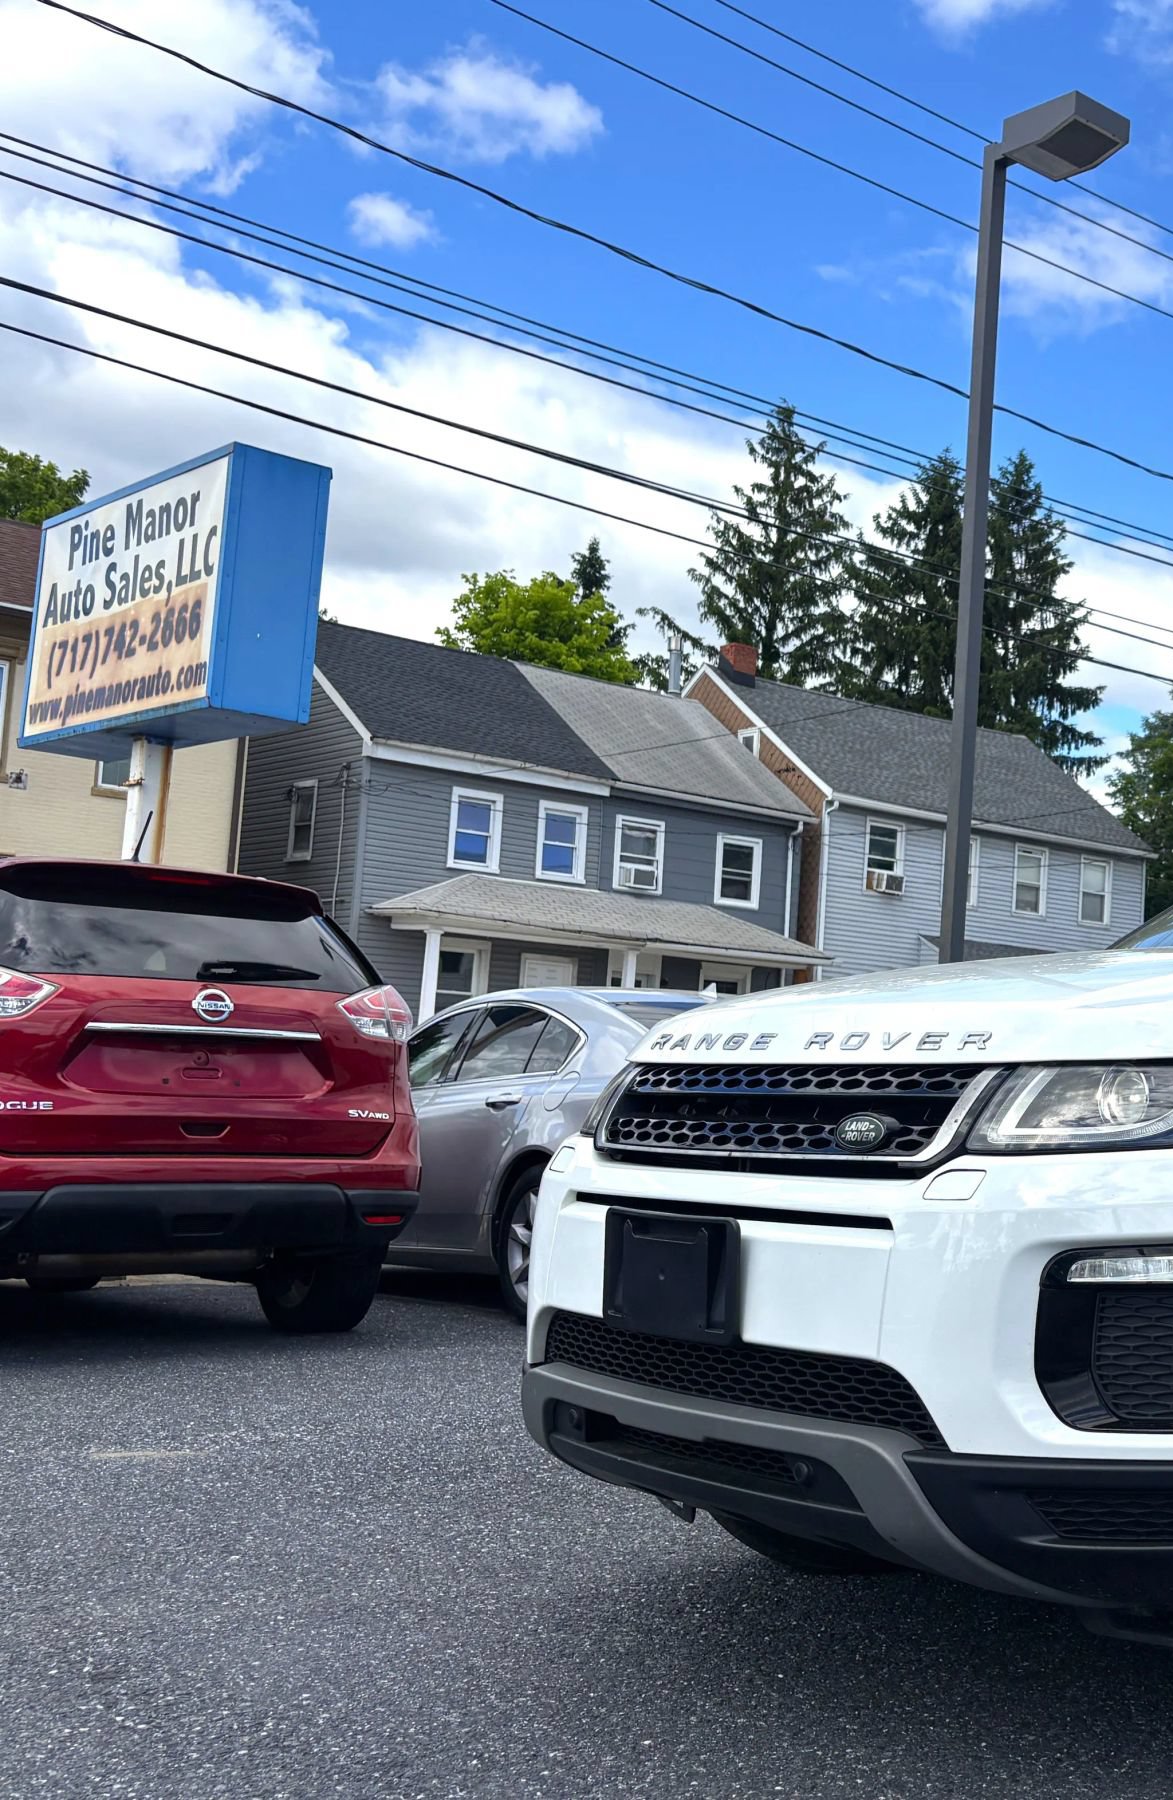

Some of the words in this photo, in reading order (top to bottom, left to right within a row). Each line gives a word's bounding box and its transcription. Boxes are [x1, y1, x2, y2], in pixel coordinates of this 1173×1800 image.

[68, 519, 116, 571] Pine
[124, 490, 201, 551] Manor
[42, 578, 96, 628] Auto
[29, 660, 208, 726] www.pinemanorauto.com
[197, 1001, 231, 1010] NISSAN
[650, 1032, 779, 1050] RANGE
[803, 1030, 993, 1050] ROVER
